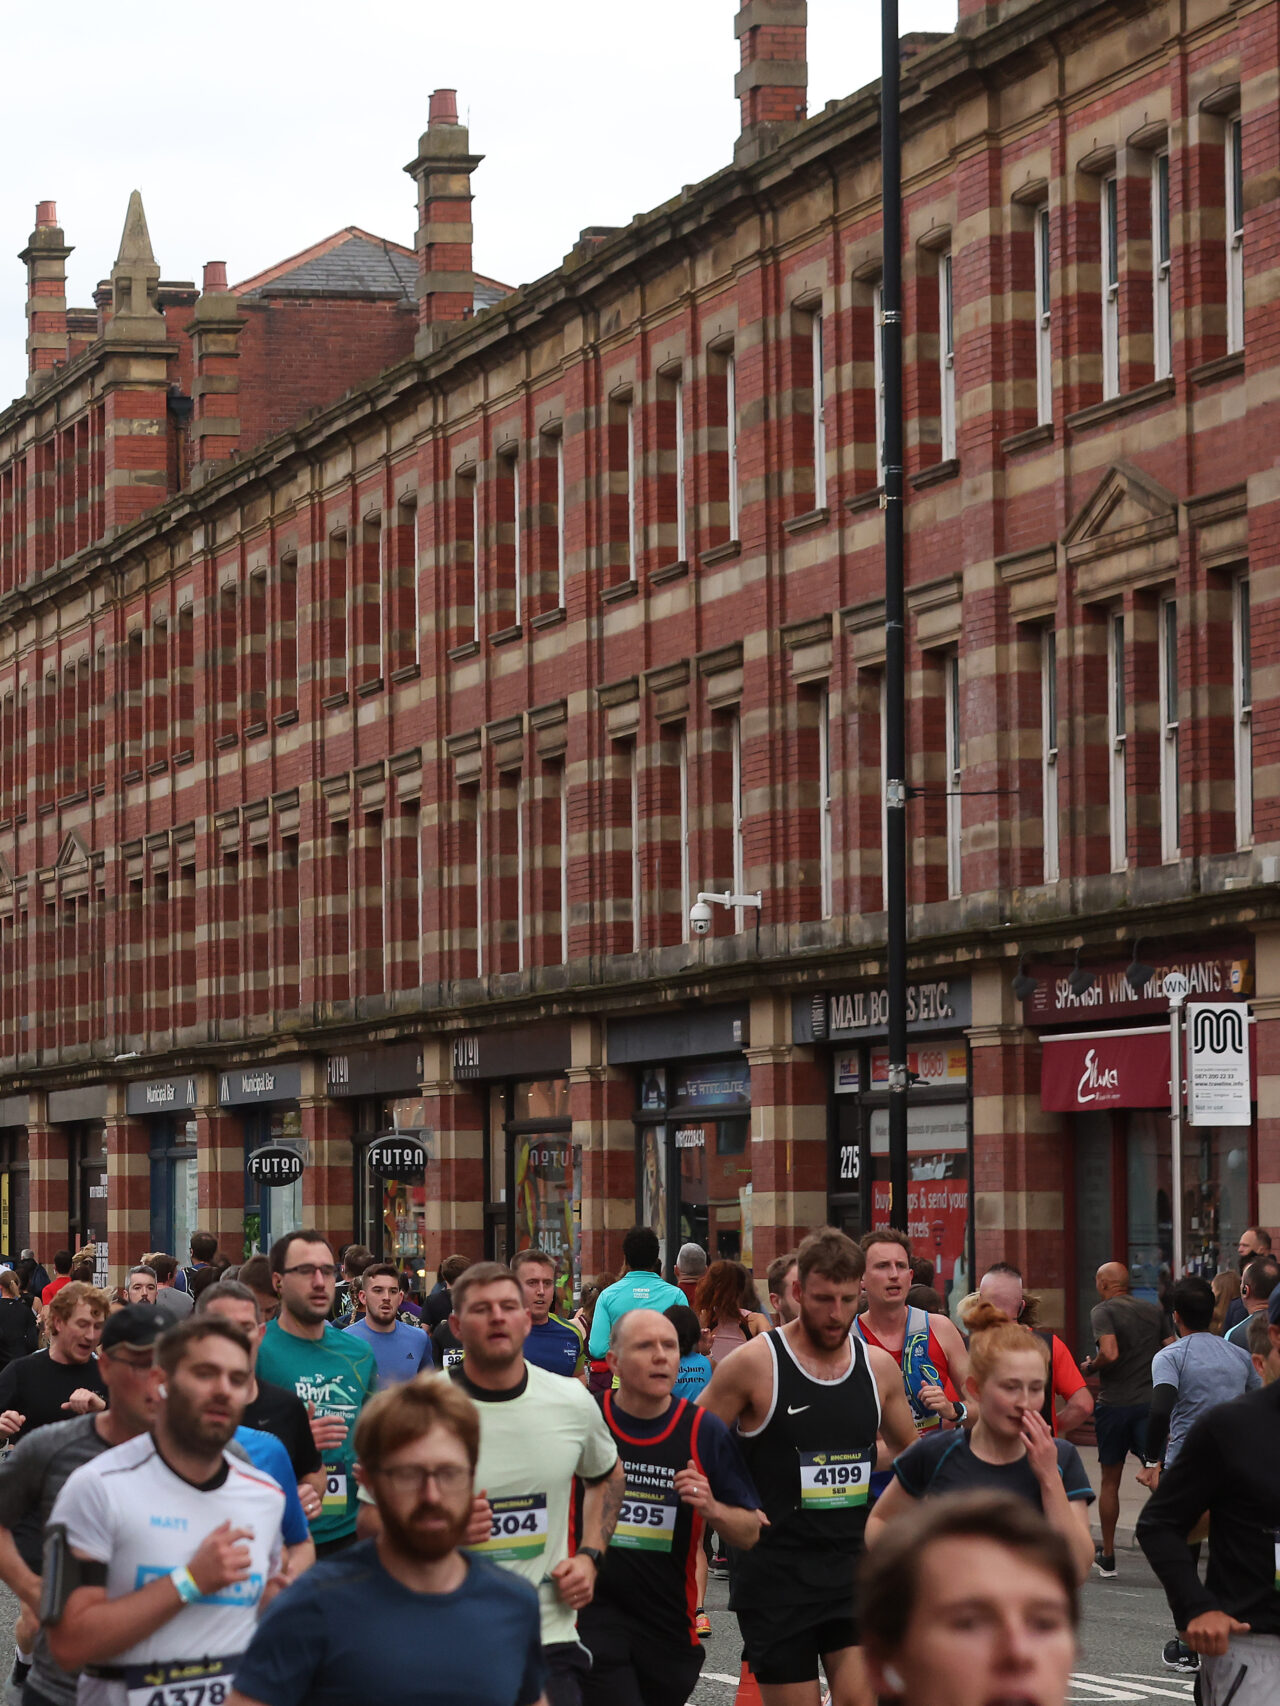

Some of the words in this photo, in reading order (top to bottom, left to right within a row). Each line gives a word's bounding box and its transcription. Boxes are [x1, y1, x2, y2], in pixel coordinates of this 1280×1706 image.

[1164, 980, 1187, 993] WN
[831, 993, 867, 1029] MAIL
[871, 980, 918, 1025] BOS
[919, 981, 952, 1019] ETC.
[456, 1037, 479, 1066] FUTON
[327, 1056, 349, 1083] FUTON
[146, 1082, 167, 1106] Municipal
[167, 1084, 175, 1100] Bar
[242, 1074, 265, 1097] Municipal
[265, 1073, 275, 1091] Bar
[252, 1158, 299, 1173] FUTON
[372, 1149, 423, 1165] FUTON
[841, 1146, 860, 1178] 275
[928, 1188, 947, 1207] send
[949, 1193, 968, 1213] your
[908, 1216, 929, 1238] arcels
[539, 1232, 560, 1250] SALE
[676, 1376, 706, 1384] unners
[295, 1382, 330, 1403] Rhyl
[324, 1409, 355, 1418] Marathon
[622, 1461, 676, 1477] CHESTER
[813, 1466, 862, 1485] 4199
[147, 1681, 227, 1706] 4378
